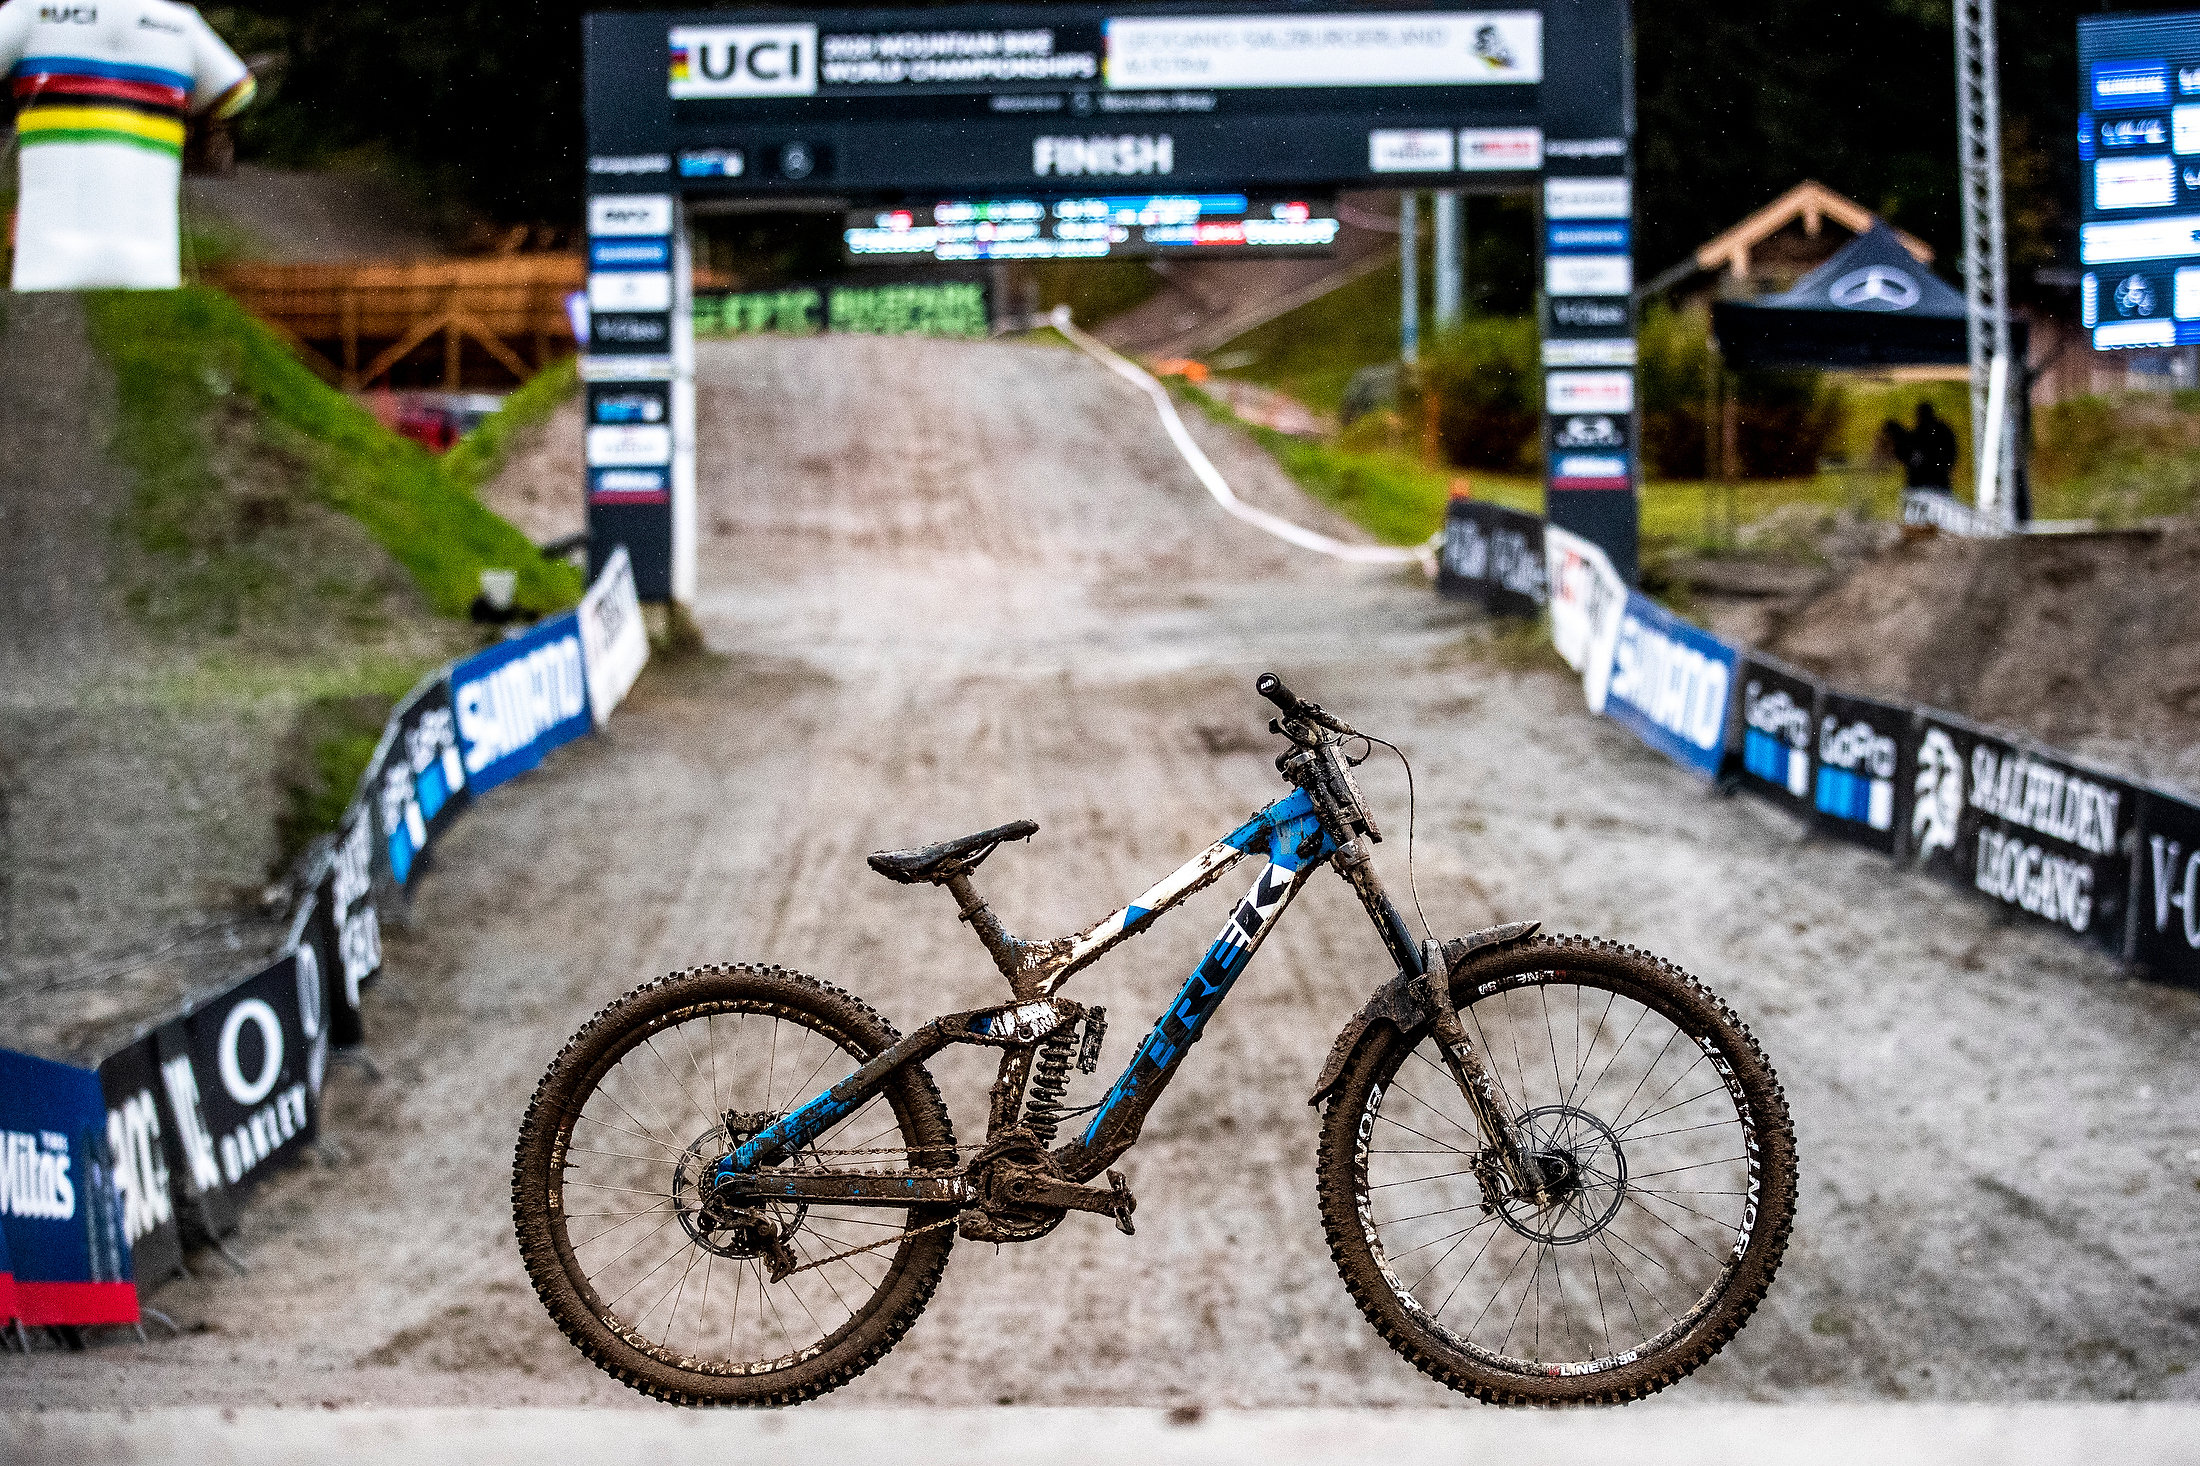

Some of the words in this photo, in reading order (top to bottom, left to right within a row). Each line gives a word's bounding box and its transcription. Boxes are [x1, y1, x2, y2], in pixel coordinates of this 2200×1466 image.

[700, 42, 801, 81] UCI
[1033, 134, 1174, 177] FINISH
[1819, 715, 1897, 778] GoPro
[1970, 744, 2120, 854] SAALFELDEN
[1976, 827, 2096, 932] LEOGANG
[1118, 862, 1290, 1090] TREK
[220, 1083, 308, 1184] OAKLEY
